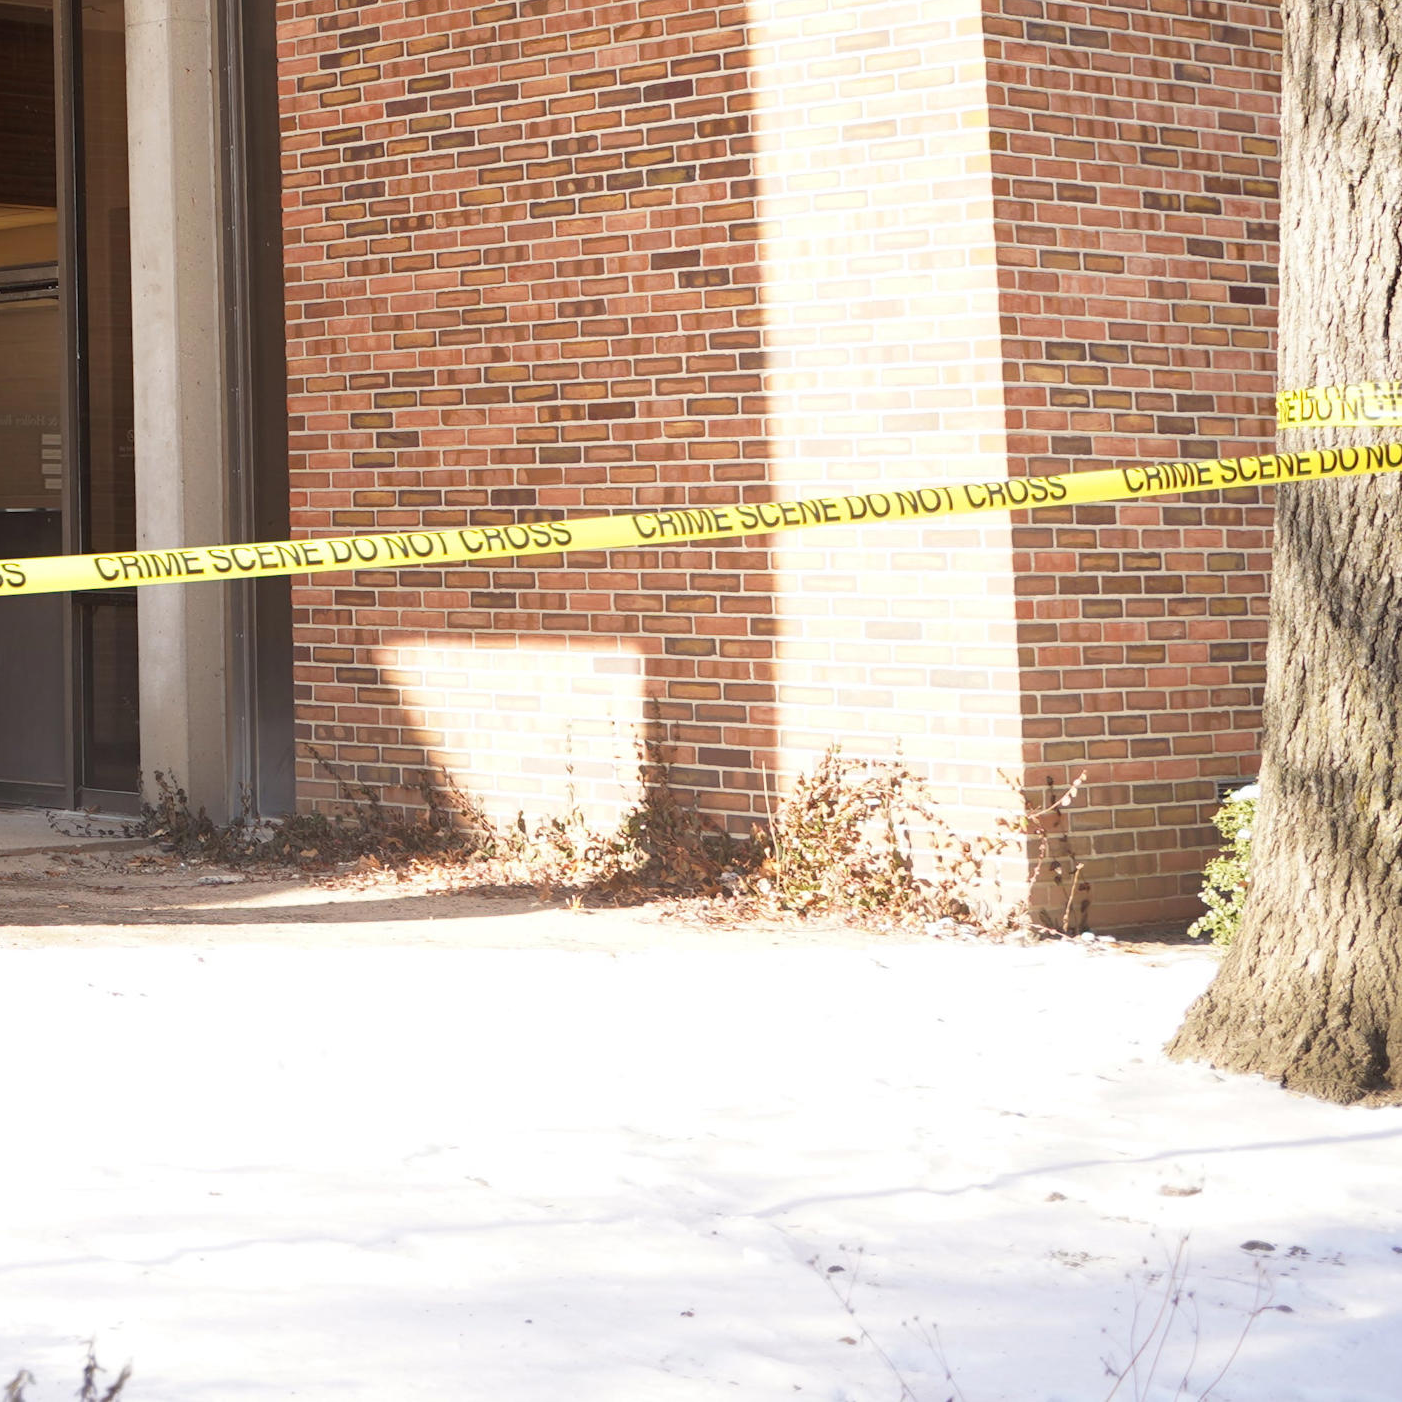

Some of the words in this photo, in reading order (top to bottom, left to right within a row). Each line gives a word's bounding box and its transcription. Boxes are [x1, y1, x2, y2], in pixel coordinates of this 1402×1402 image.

[1122, 463, 1213, 493] CRIME
[1217, 453, 1312, 484] SCENE
[1319, 448, 1359, 474] DO
[632, 509, 733, 539] CRIME
[739, 499, 841, 529] SCENE
[845, 494, 891, 519] DO
[895, 487, 957, 515] NOT
[963, 476, 1067, 508] CROSS
[94, 552, 204, 581] CRIME
[213, 543, 323, 573] SCENE
[331, 540, 378, 564] DO
[385, 532, 450, 559] NOT
[459, 525, 572, 553] CROSS
